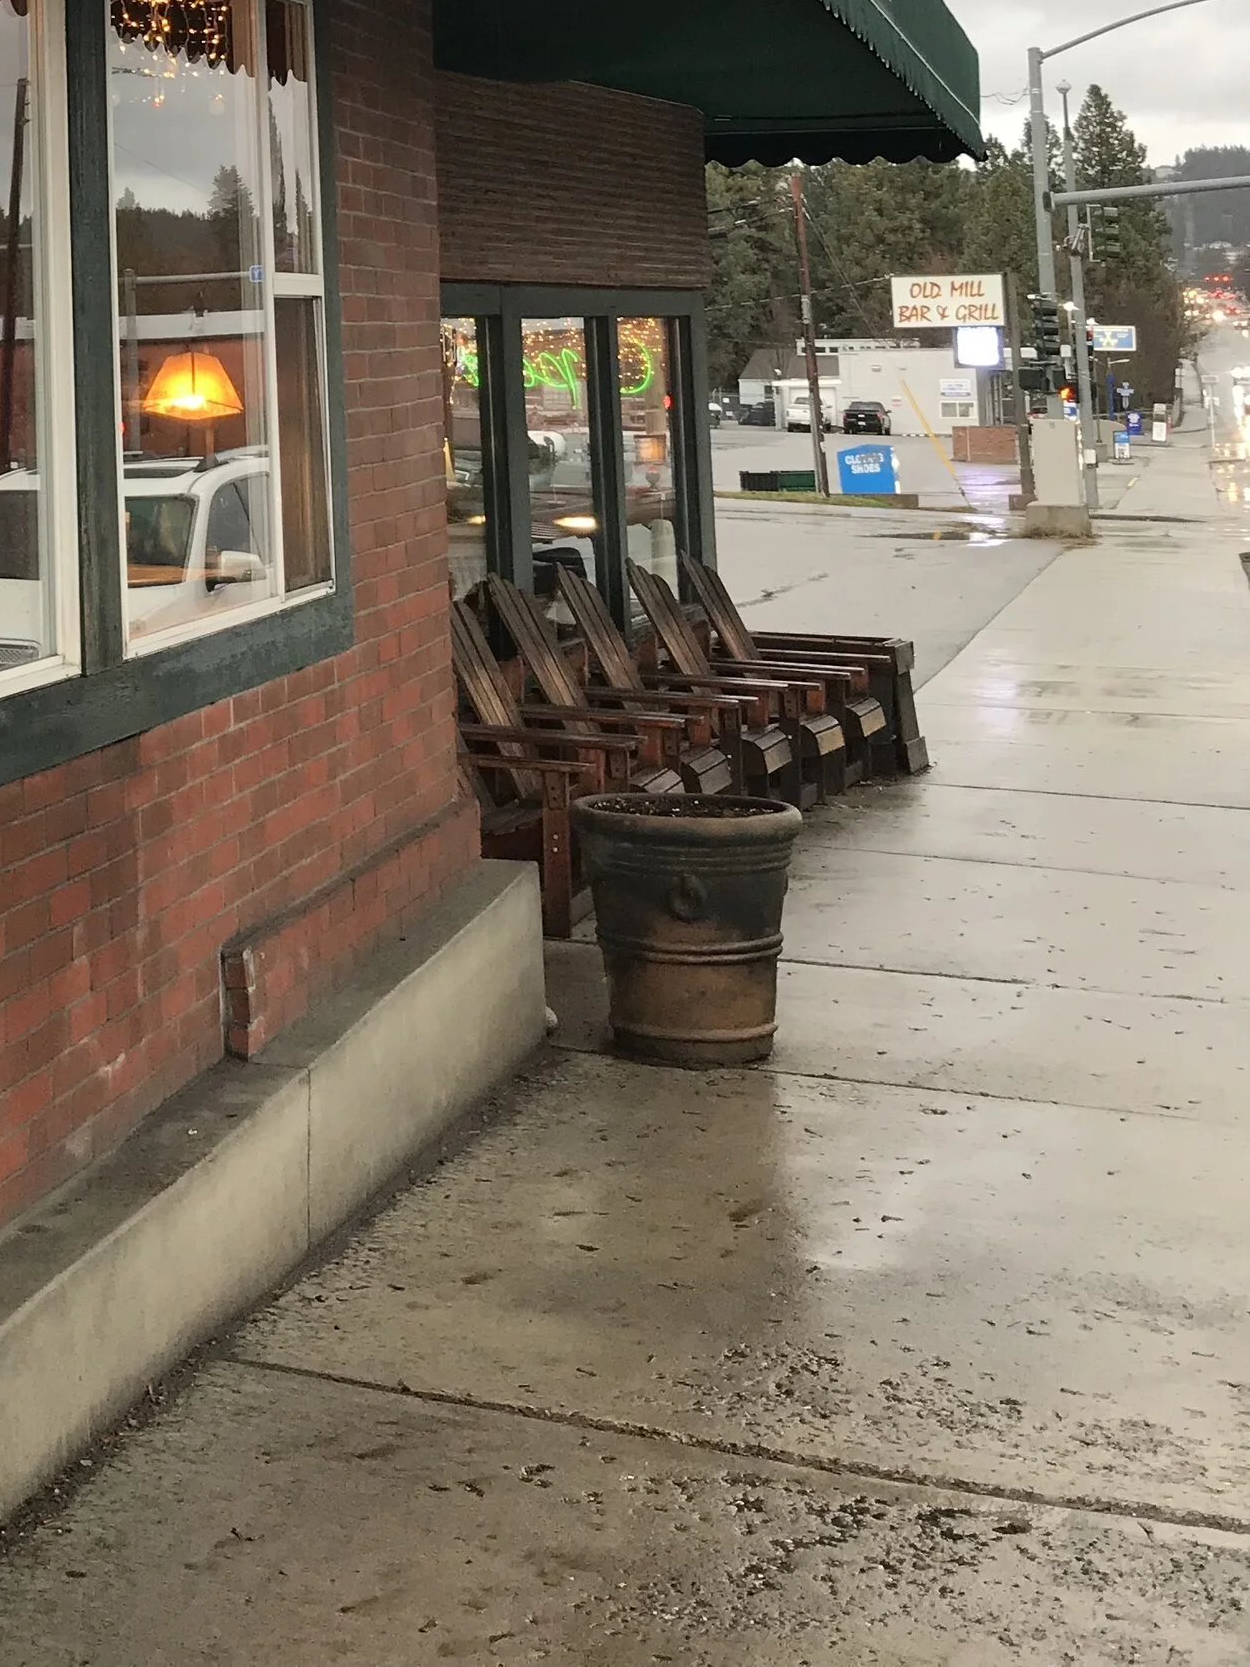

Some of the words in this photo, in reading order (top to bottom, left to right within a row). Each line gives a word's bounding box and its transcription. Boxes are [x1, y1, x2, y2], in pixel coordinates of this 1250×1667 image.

[909, 283, 942, 299] OLD
[950, 280, 985, 297] MILL
[898, 305, 932, 323] BAR
[936, 305, 950, 320] &
[955, 303, 999, 323] GRILL
[851, 463, 881, 474] SHOES
